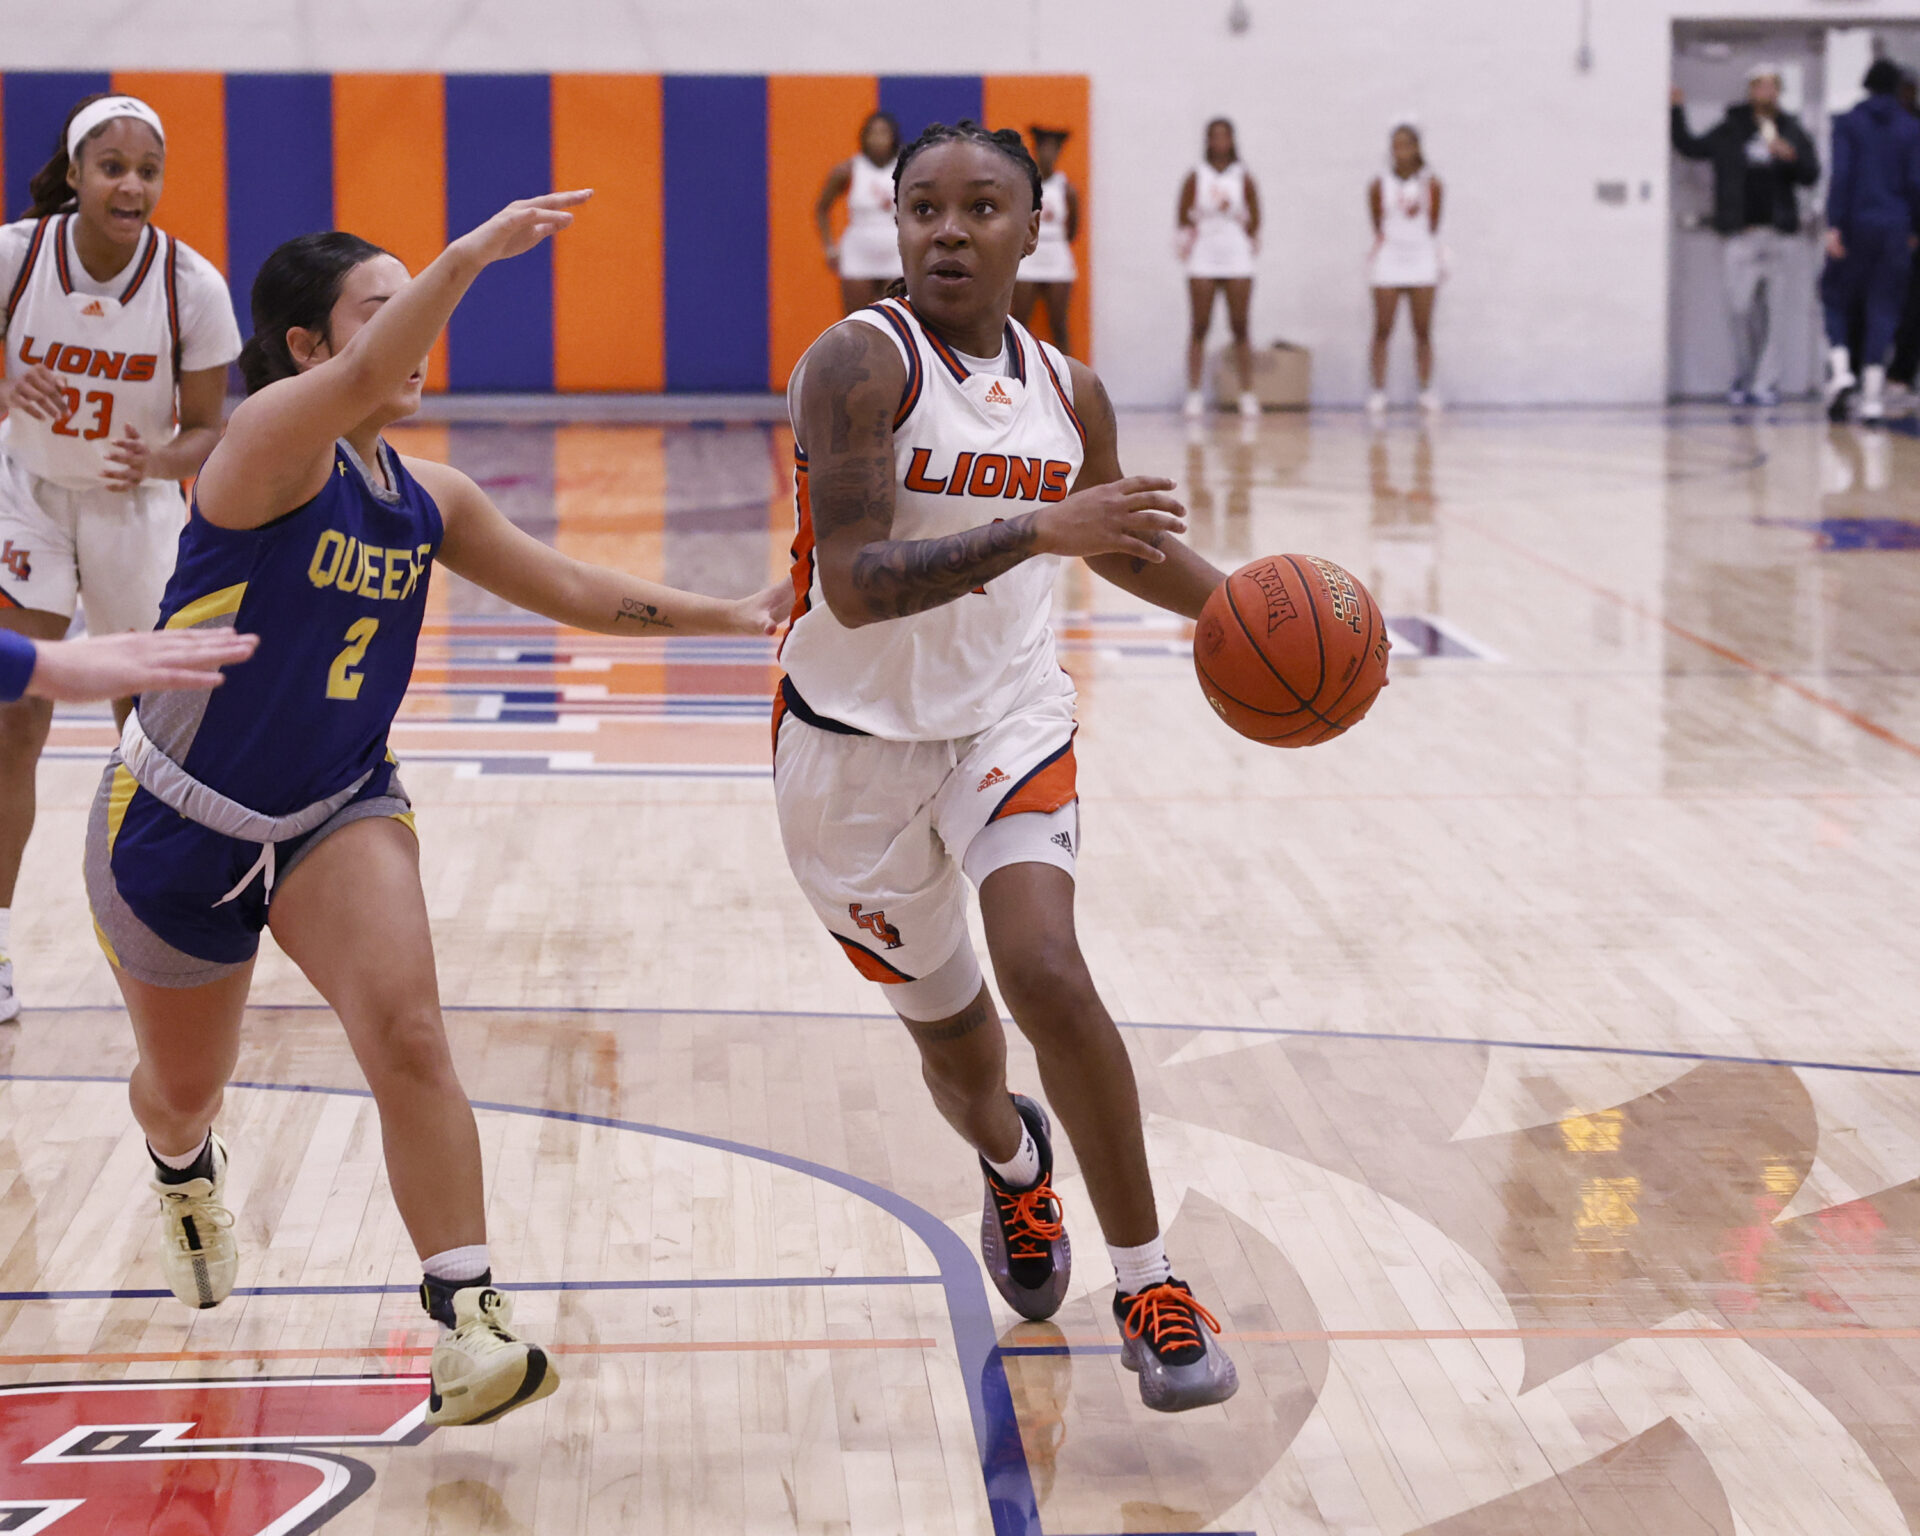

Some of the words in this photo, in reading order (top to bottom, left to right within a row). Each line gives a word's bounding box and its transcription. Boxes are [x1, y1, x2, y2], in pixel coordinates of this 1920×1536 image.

[19, 335, 158, 382] LIONS
[51, 387, 114, 441] 23
[985, 395, 1012, 404] adidas
[904, 447, 1072, 502] LIONS
[1243, 562, 1298, 637] NAIA
[325, 616, 380, 701] 2
[976, 774, 1011, 792] adidas
